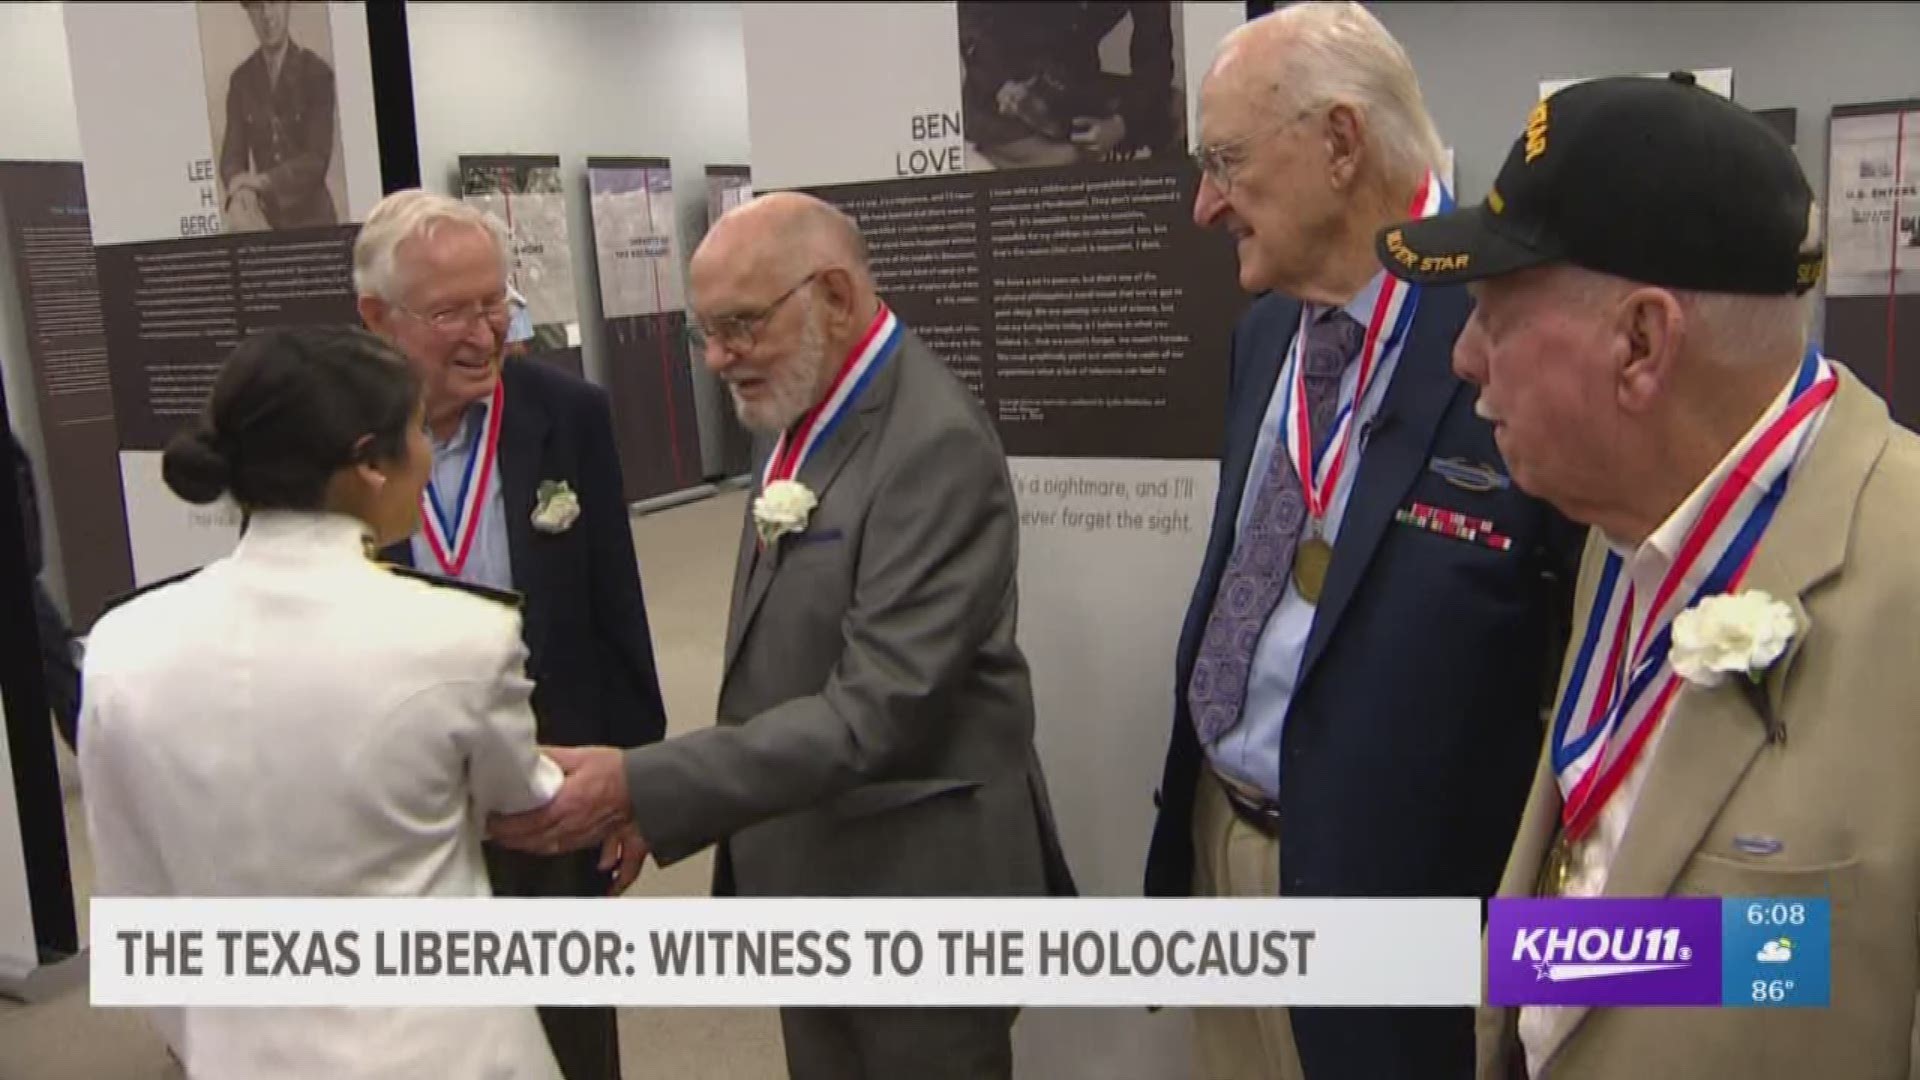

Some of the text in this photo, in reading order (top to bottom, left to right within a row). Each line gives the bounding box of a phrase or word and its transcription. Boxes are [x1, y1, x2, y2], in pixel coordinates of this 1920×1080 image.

[912, 111, 960, 140] BEN
[188, 160, 214, 181] LEE
[897, 146, 961, 175] LOVE
[180, 214, 220, 235] BERG
[1419, 253, 1469, 272] STAR
[1044, 476, 1129, 500] nightmare,
[1136, 479, 1168, 498] and
[1021, 507, 1193, 534] ever forget the sight.
